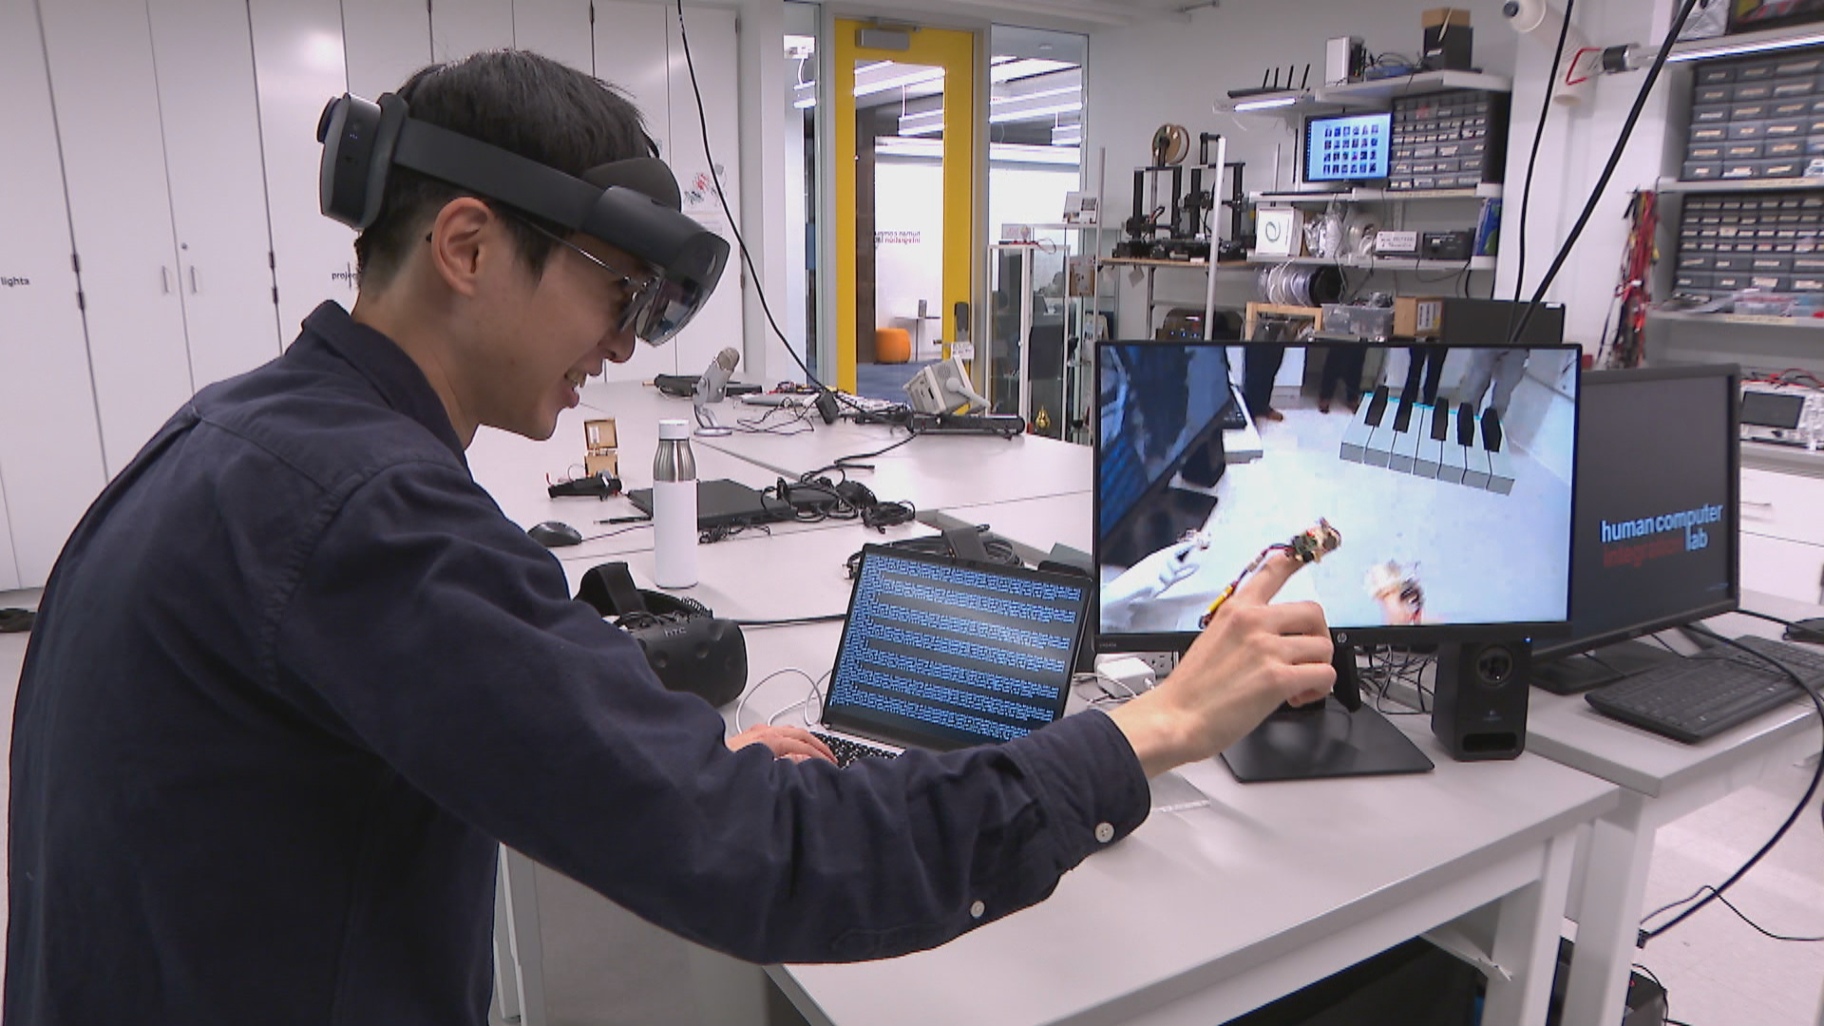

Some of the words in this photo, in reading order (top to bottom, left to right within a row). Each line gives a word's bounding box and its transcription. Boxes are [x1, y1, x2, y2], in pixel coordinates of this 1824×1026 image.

[1601, 517, 1655, 543] human
[1655, 503, 1723, 532] computer
[1685, 525, 1708, 551] lab
